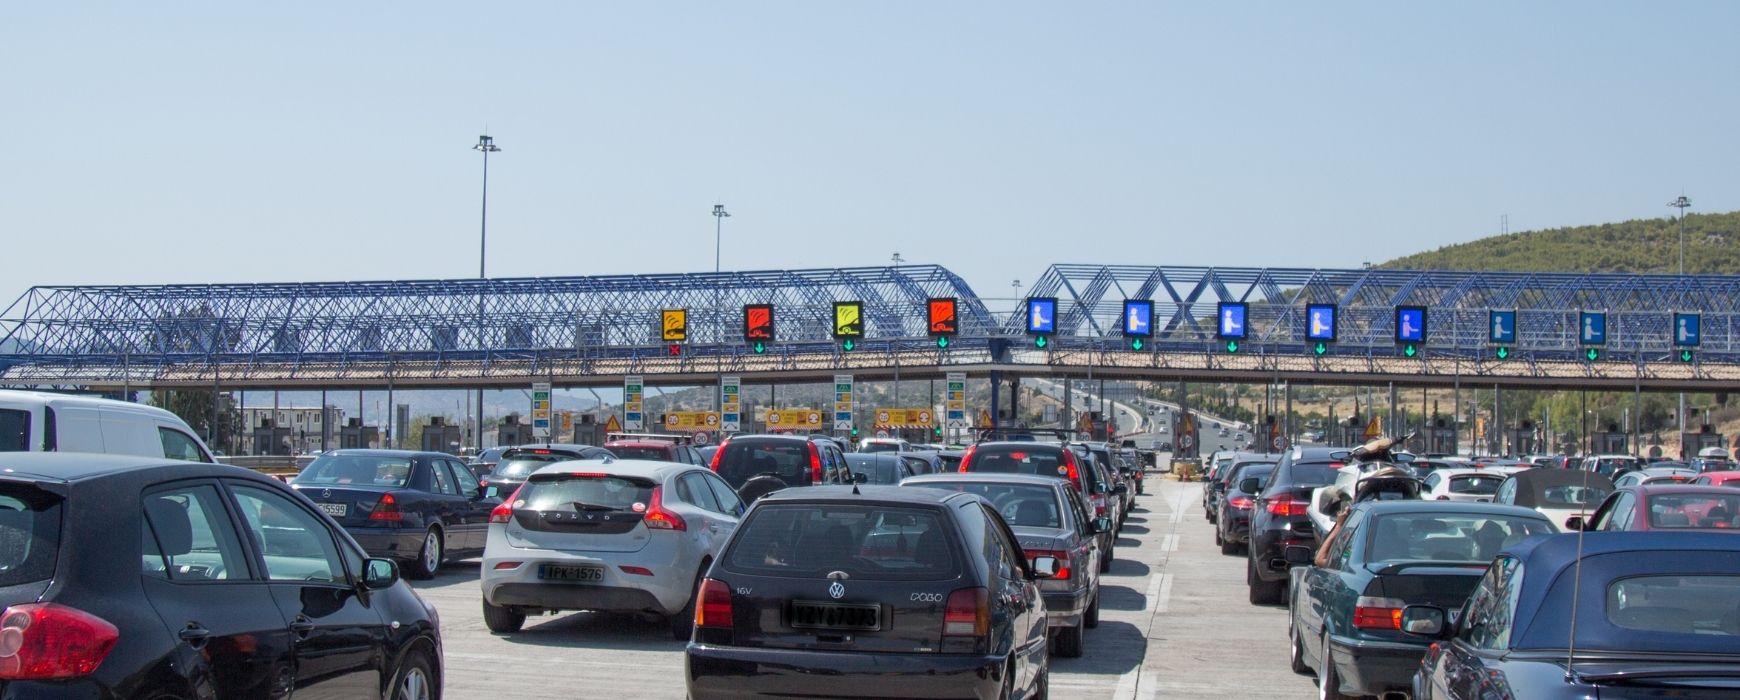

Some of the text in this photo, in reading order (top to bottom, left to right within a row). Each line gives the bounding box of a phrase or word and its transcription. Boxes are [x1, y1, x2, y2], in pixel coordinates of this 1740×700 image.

[696, 435, 707, 443] 20
[539, 512, 610, 520] VOLVO
[736, 587, 753, 595] 16V
